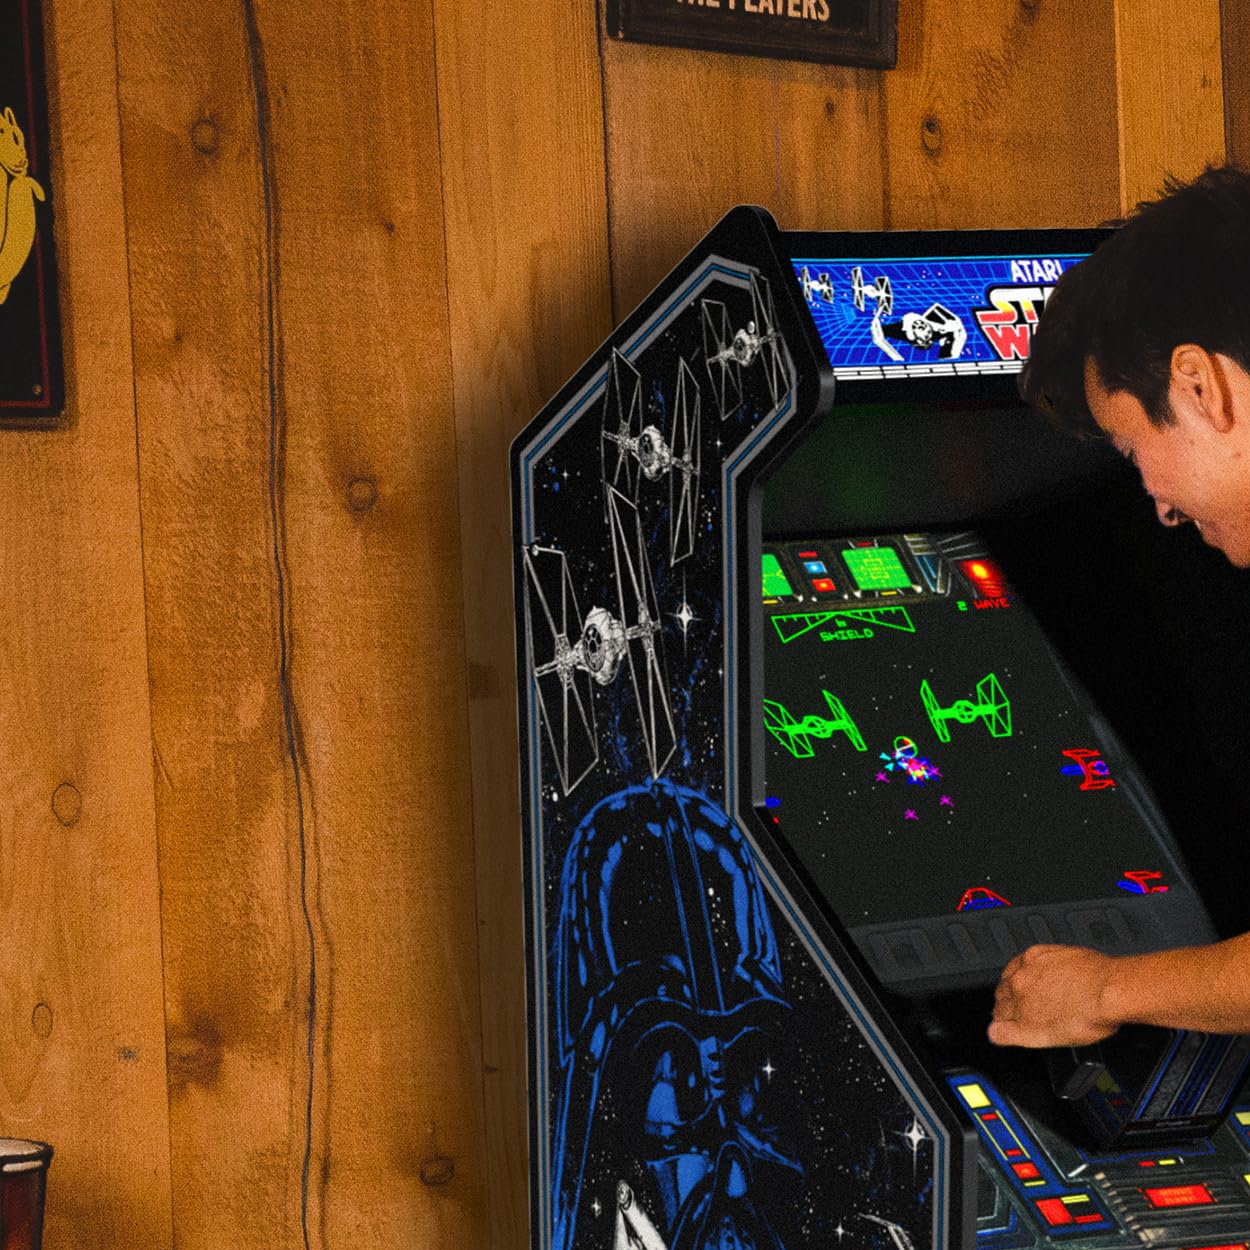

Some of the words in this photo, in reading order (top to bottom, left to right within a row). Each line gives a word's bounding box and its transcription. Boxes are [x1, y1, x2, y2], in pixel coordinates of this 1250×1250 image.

[1011, 259, 1063, 283] ATARI
[976, 287, 1055, 325] ST
[974, 598, 1010, 609] WAVE
[819, 628, 875, 642] SHIELD
